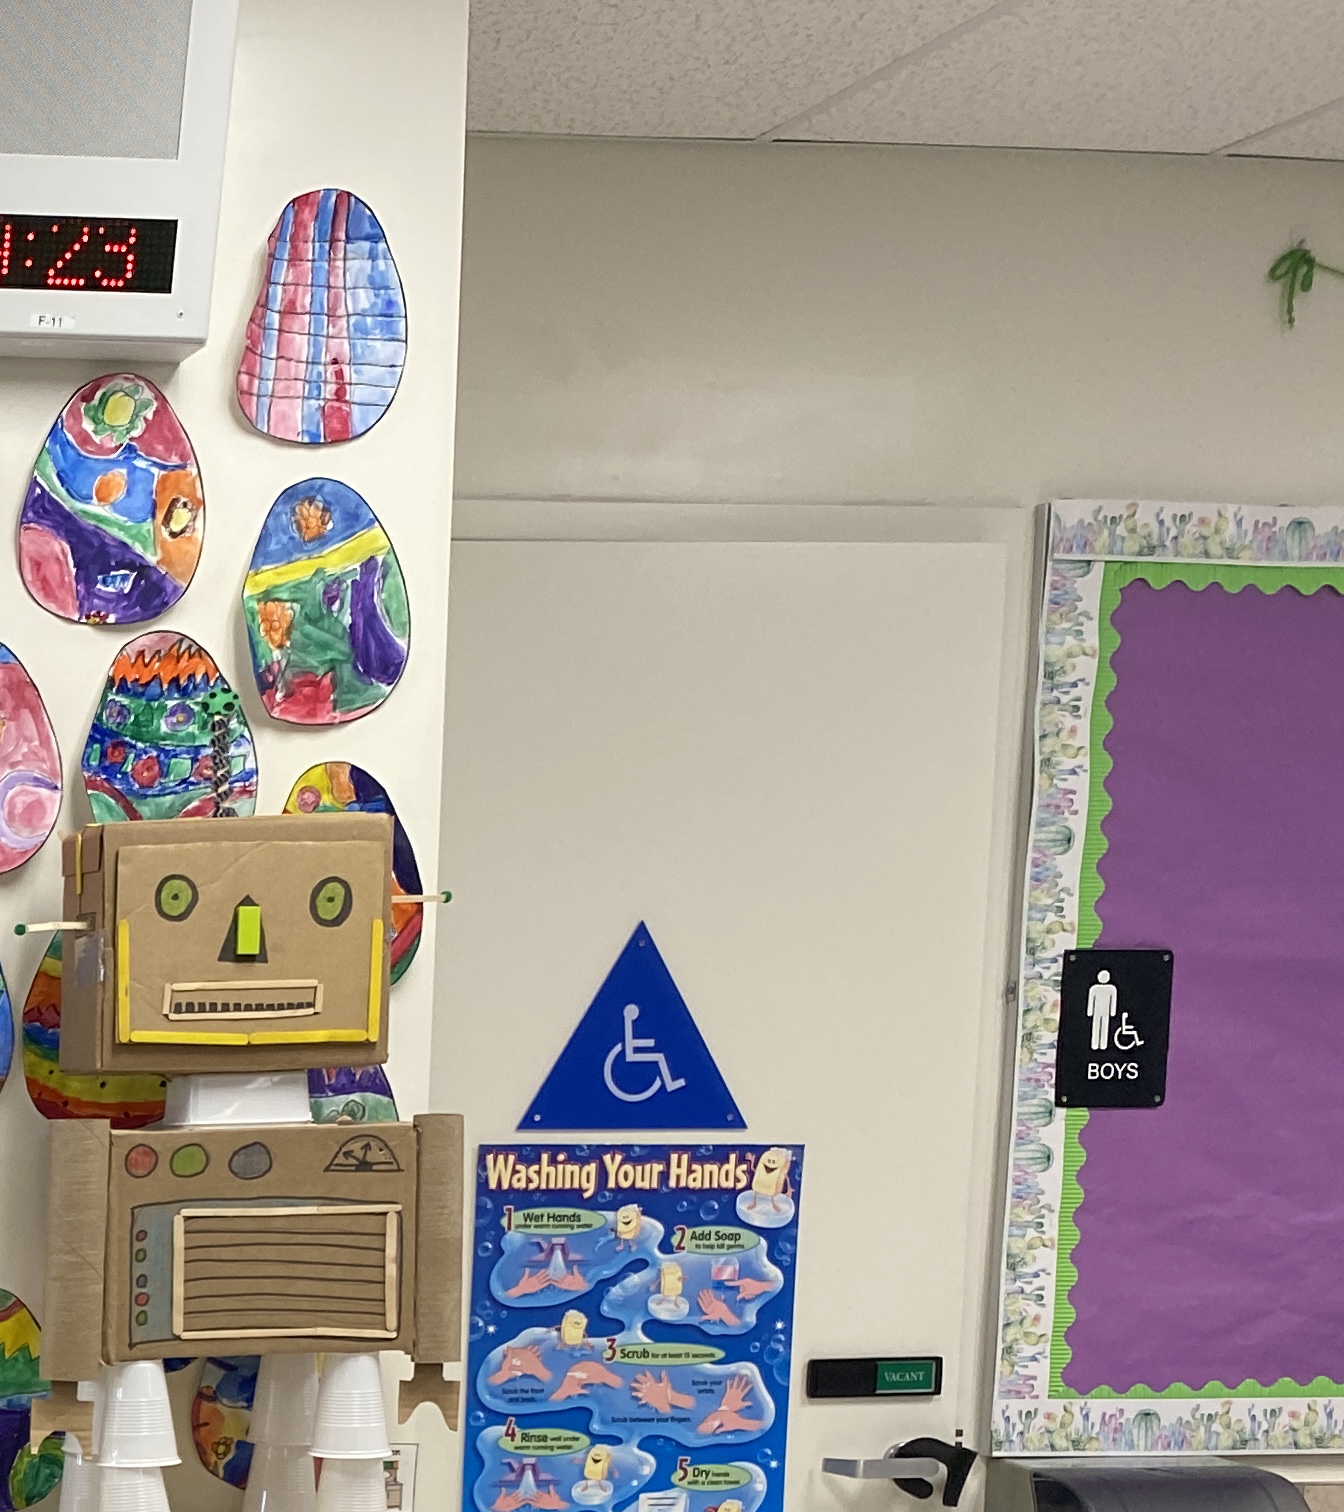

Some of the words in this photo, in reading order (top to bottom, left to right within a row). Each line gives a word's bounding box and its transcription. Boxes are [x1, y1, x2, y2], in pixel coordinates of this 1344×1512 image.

[1086, 1061, 1140, 1081] BOYS
[485, 1151, 599, 1200] Washing
[602, 1152, 665, 1190] Your
[668, 1152, 749, 1190] Hands
[504, 1205, 514, 1232] 1
[522, 1212, 544, 1223] Wet
[546, 1212, 582, 1223] Hands
[674, 1225, 687, 1252] 2
[690, 1230, 712, 1241] Add
[714, 1230, 741, 1244] Soap
[603, 1338, 617, 1363] 3
[620, 1347, 650, 1360] Scrub
[884, 1371, 925, 1382] VACANT
[505, 1417, 517, 1443] 4
[520, 1432, 548, 1443] Rinse
[677, 1456, 691, 1483] 5
[692, 1467, 711, 1480] Dry
